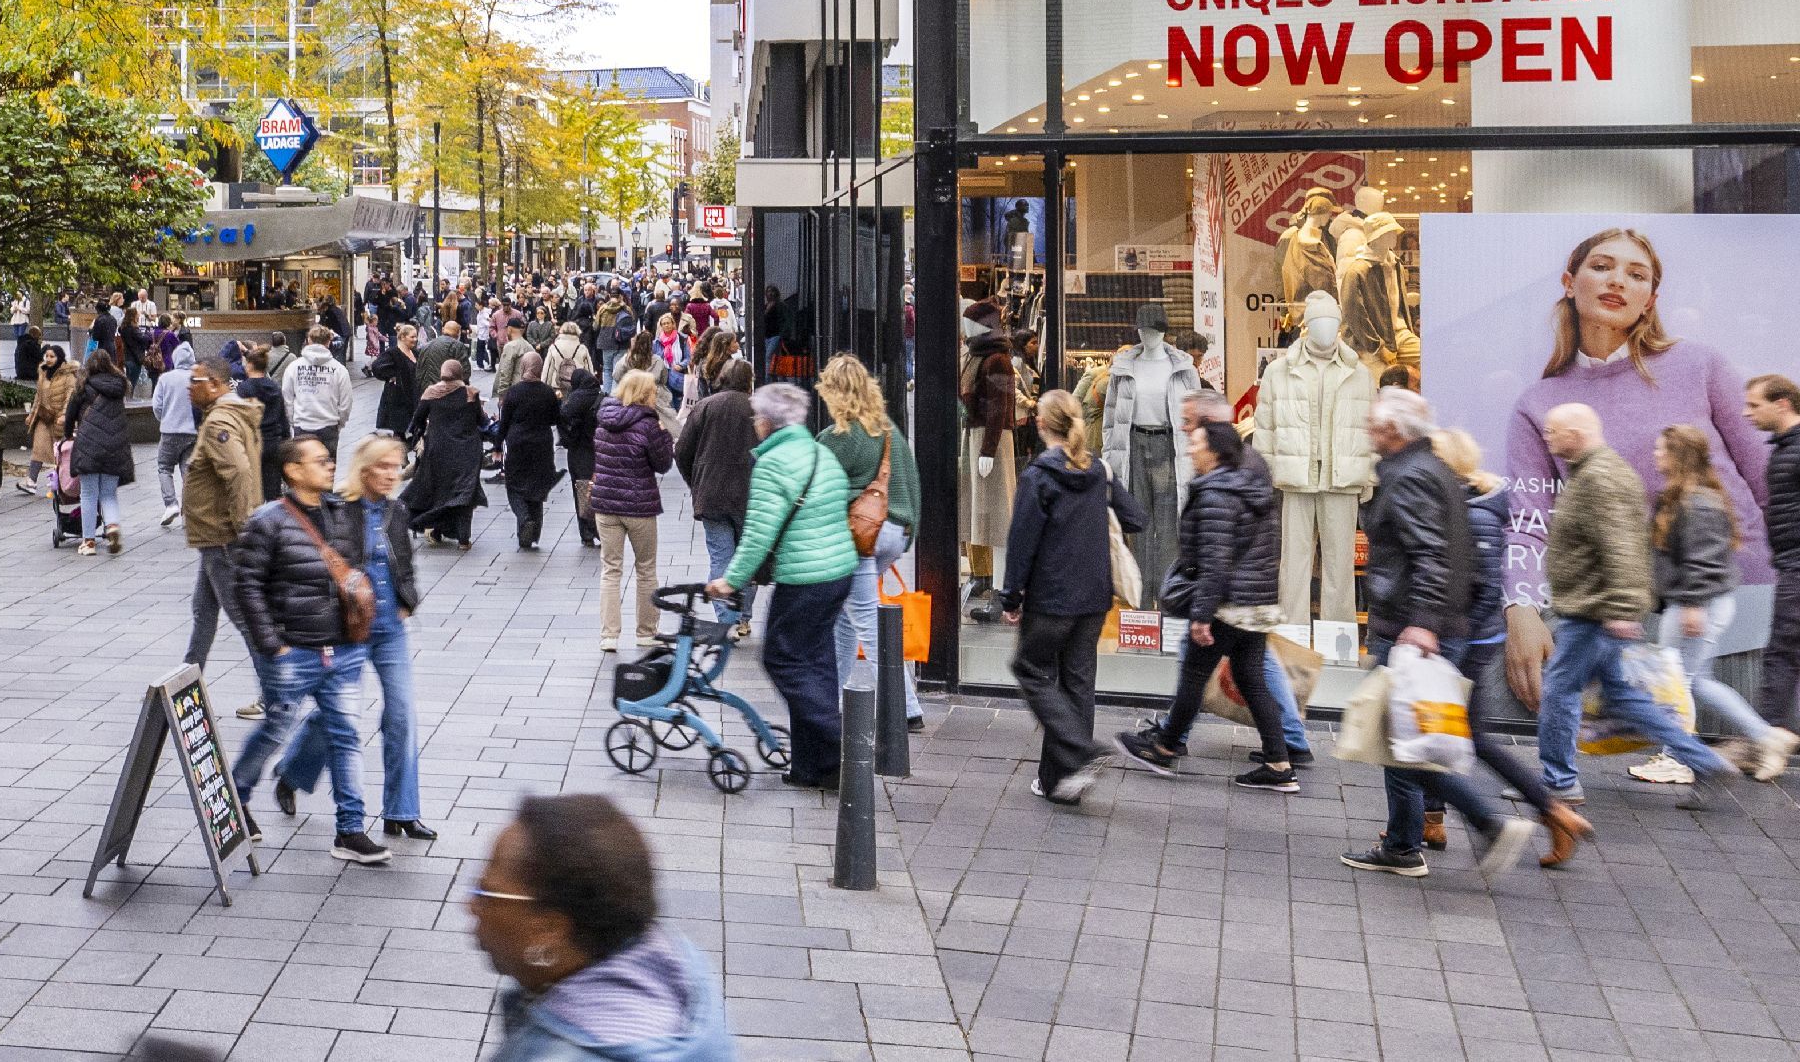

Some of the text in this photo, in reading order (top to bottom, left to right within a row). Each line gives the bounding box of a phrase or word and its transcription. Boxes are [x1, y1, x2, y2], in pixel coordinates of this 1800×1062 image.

[1166, 16, 1614, 89] NOW OPEN
[261, 118, 301, 134] BRAM
[260, 136, 301, 150] LADAGE
[1231, 152, 1300, 226] OPENING
[705, 208, 723, 218] UNI
[705, 217, 724, 227] QLO
[297, 365, 336, 374] MULTIPLY
